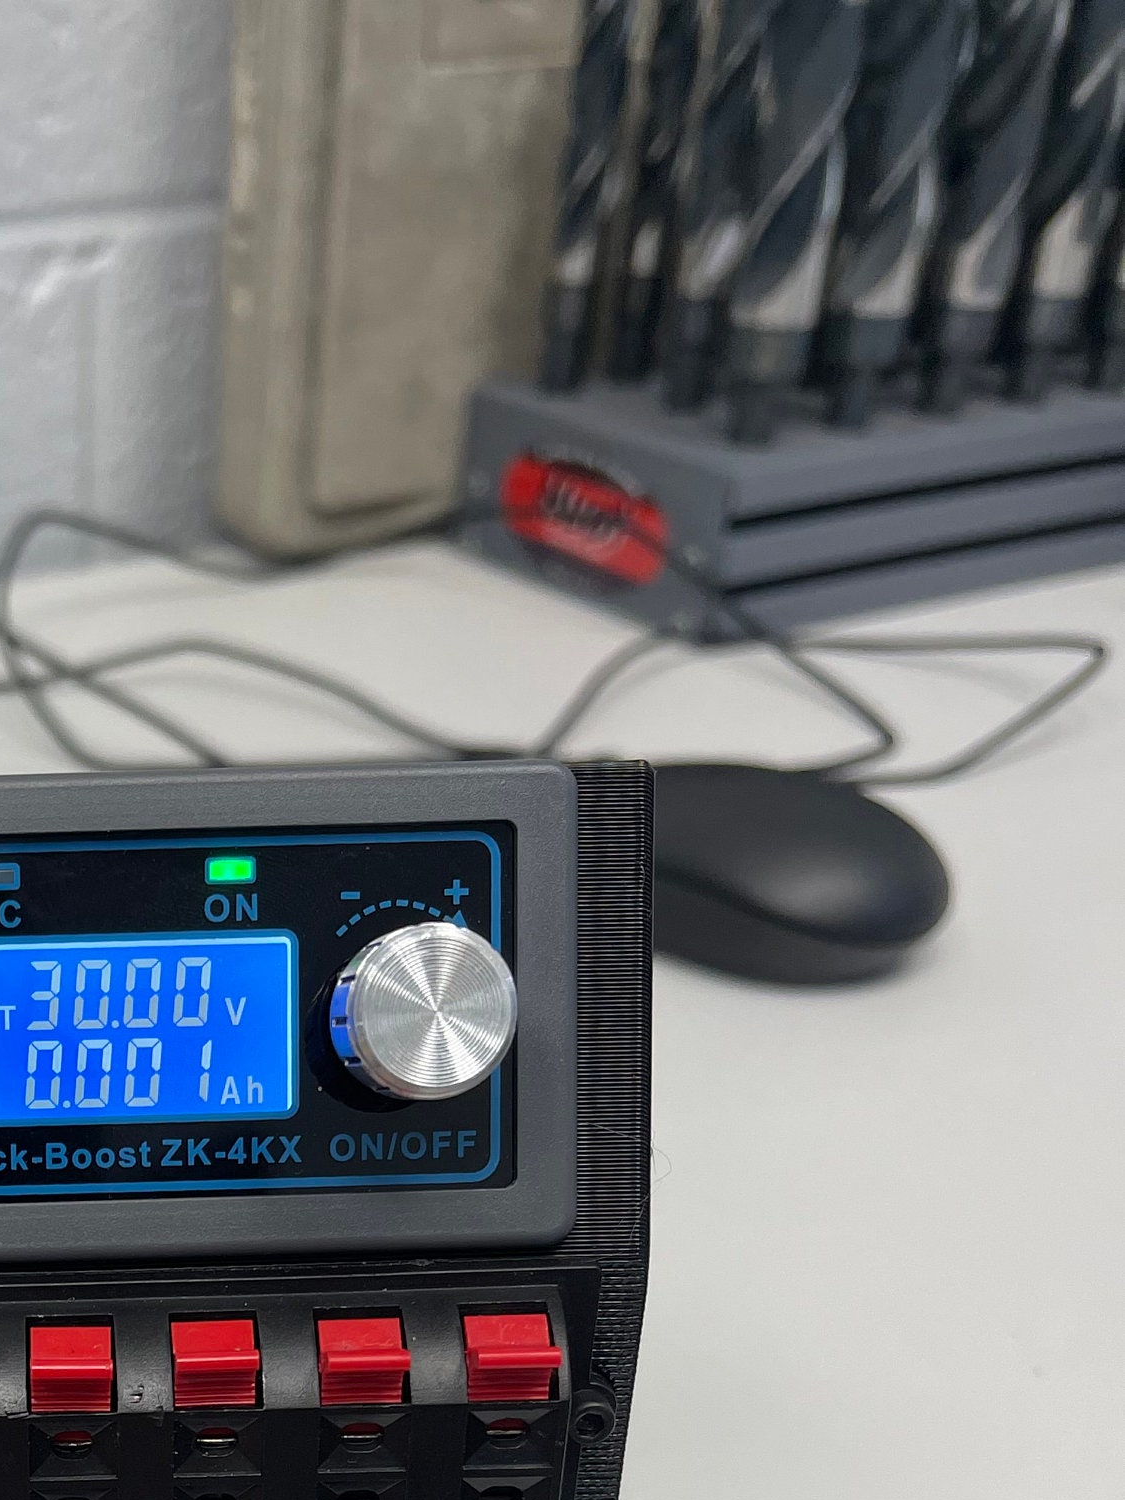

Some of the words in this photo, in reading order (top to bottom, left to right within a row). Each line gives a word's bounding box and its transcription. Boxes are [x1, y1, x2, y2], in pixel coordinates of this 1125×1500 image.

[204, 893, 259, 923] ON
[27, 956, 212, 1031] 30.00
[24, 1037, 213, 1110] 0.001
[220, 1075, 264, 1106] Ah
[160, 1135, 303, 1167] ZK-4KX
[329, 1130, 478, 1163] ON/OFF
